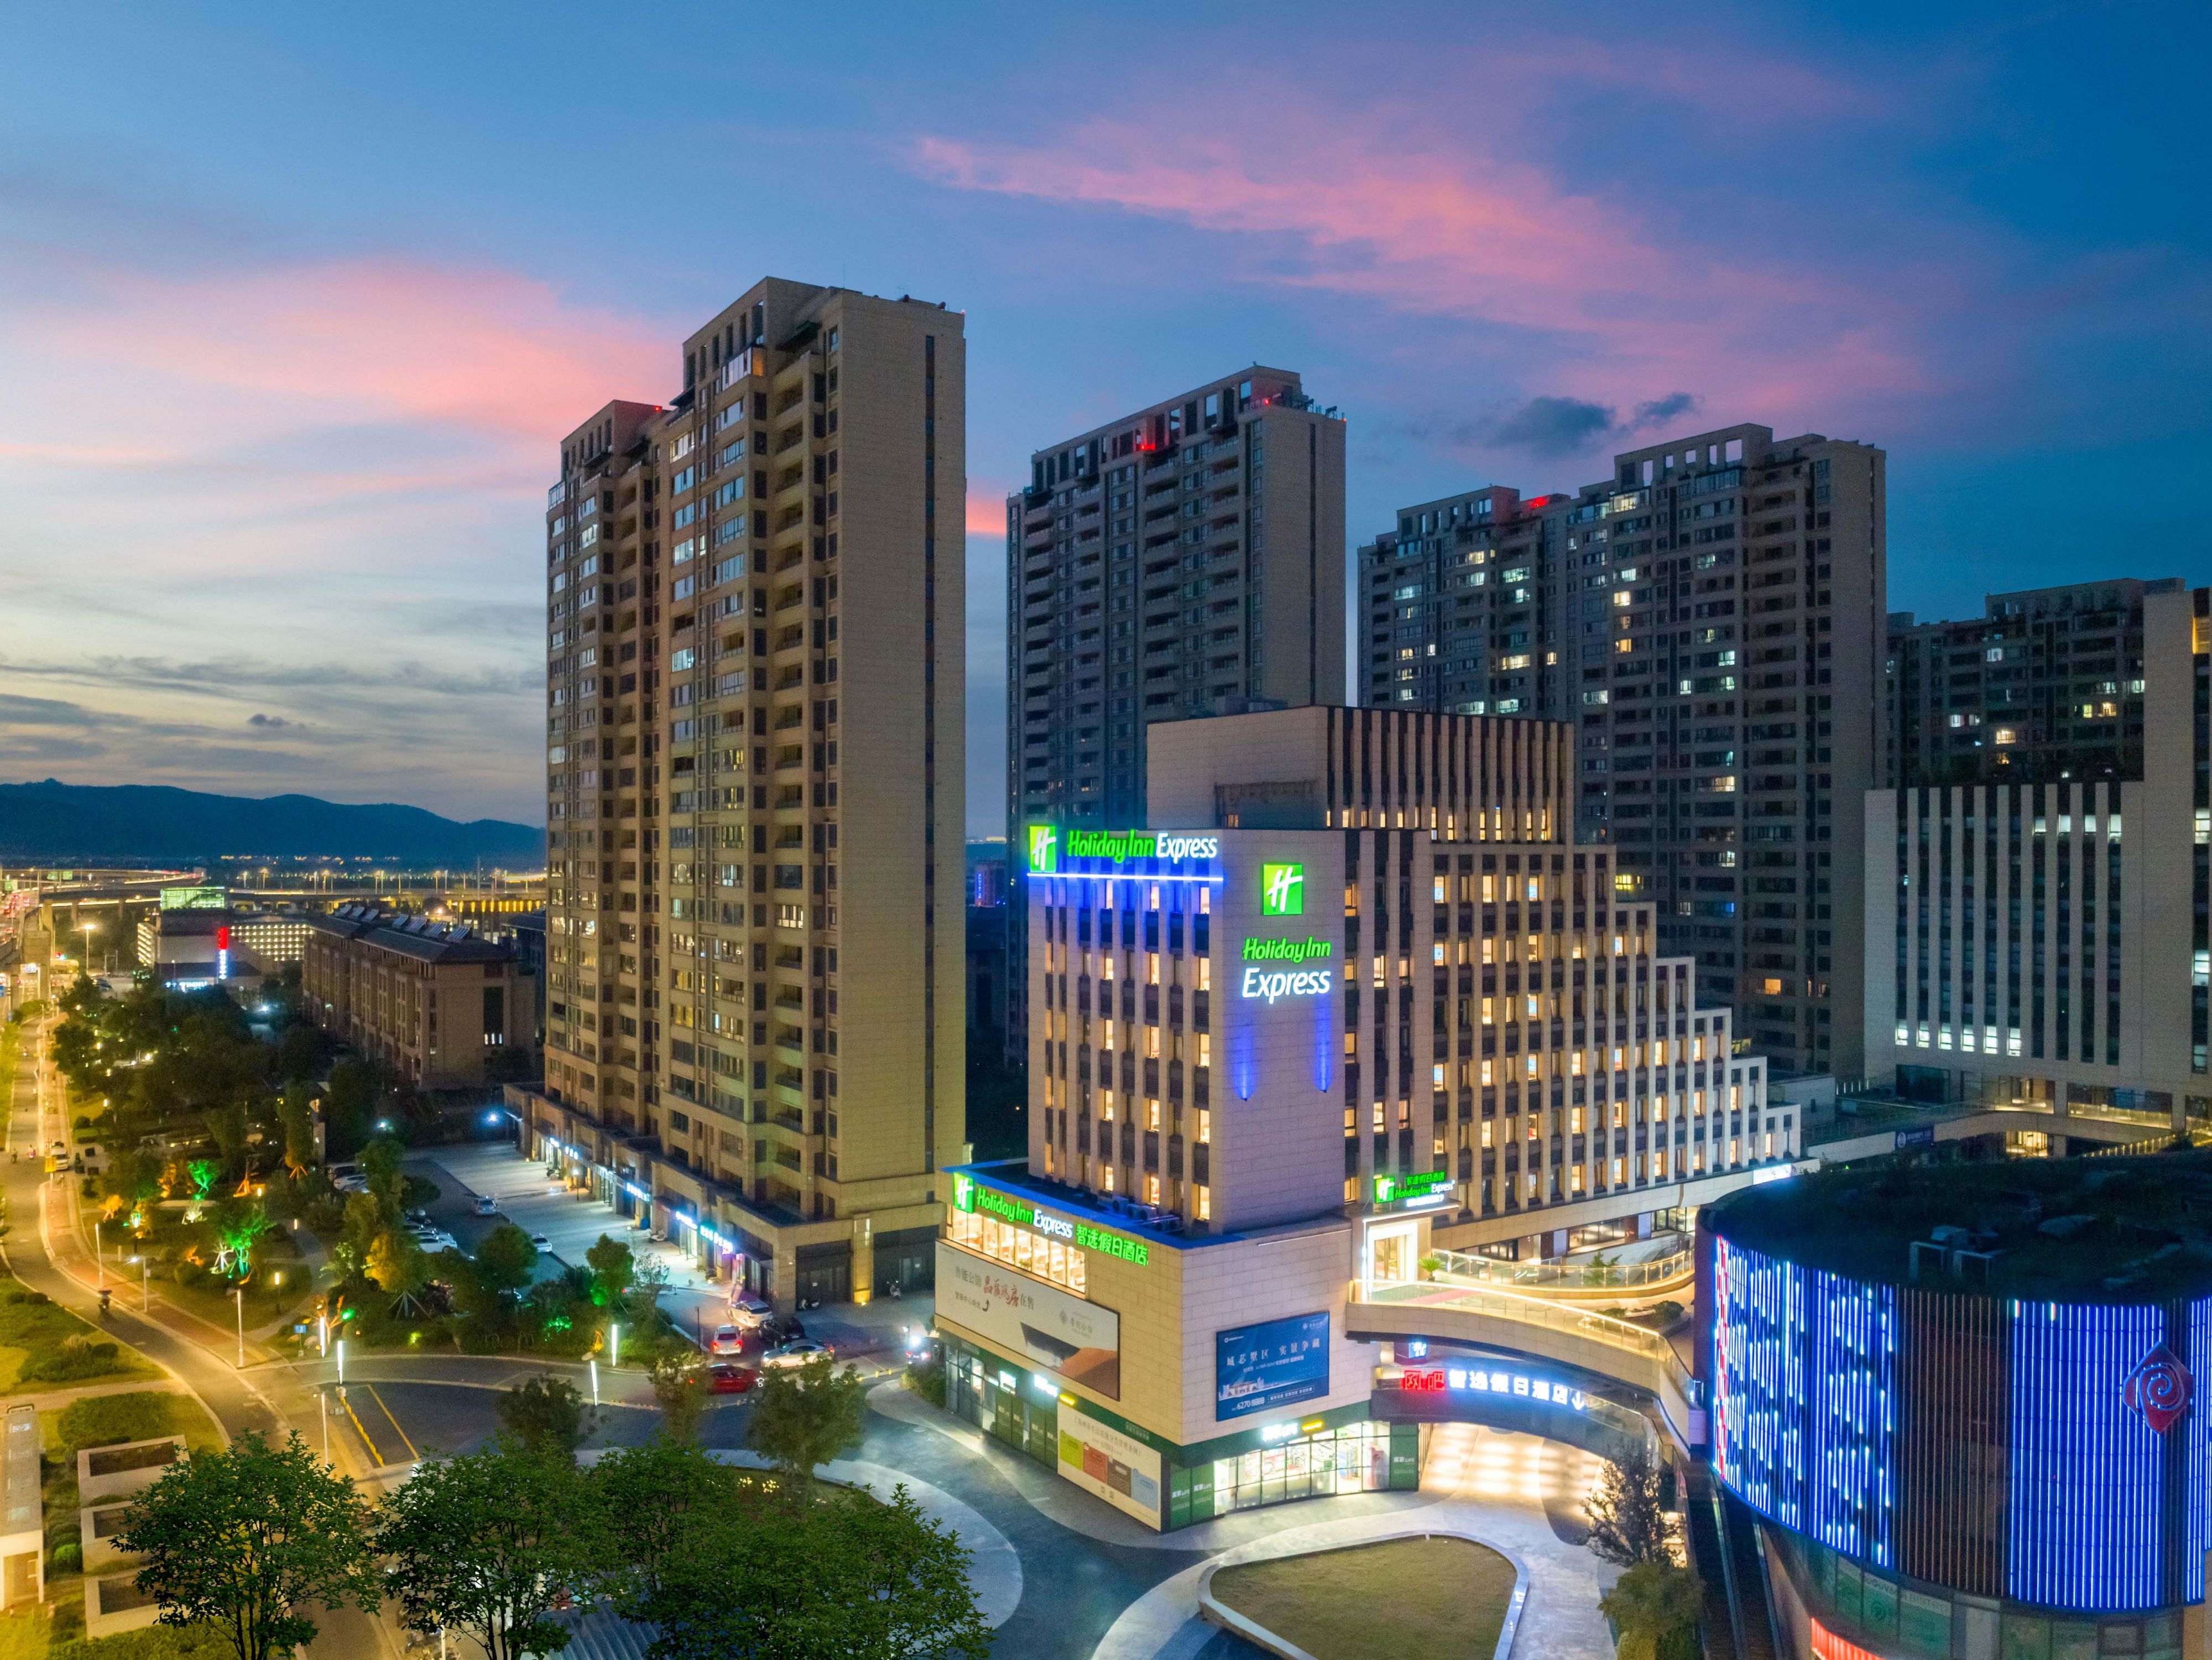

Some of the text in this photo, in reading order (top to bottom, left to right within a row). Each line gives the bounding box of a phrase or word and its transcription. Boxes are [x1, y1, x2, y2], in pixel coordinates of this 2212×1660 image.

[1156, 832, 1218, 863] Express
[1241, 967, 1332, 1004] Express
[1431, 1183, 1453, 1193] Express
[1033, 1209, 1073, 1239] Express
[1076, 1224, 1149, 1267] 智选假日酒店
[1404, 1368, 1568, 1405] 网吧 智选假日酒店
